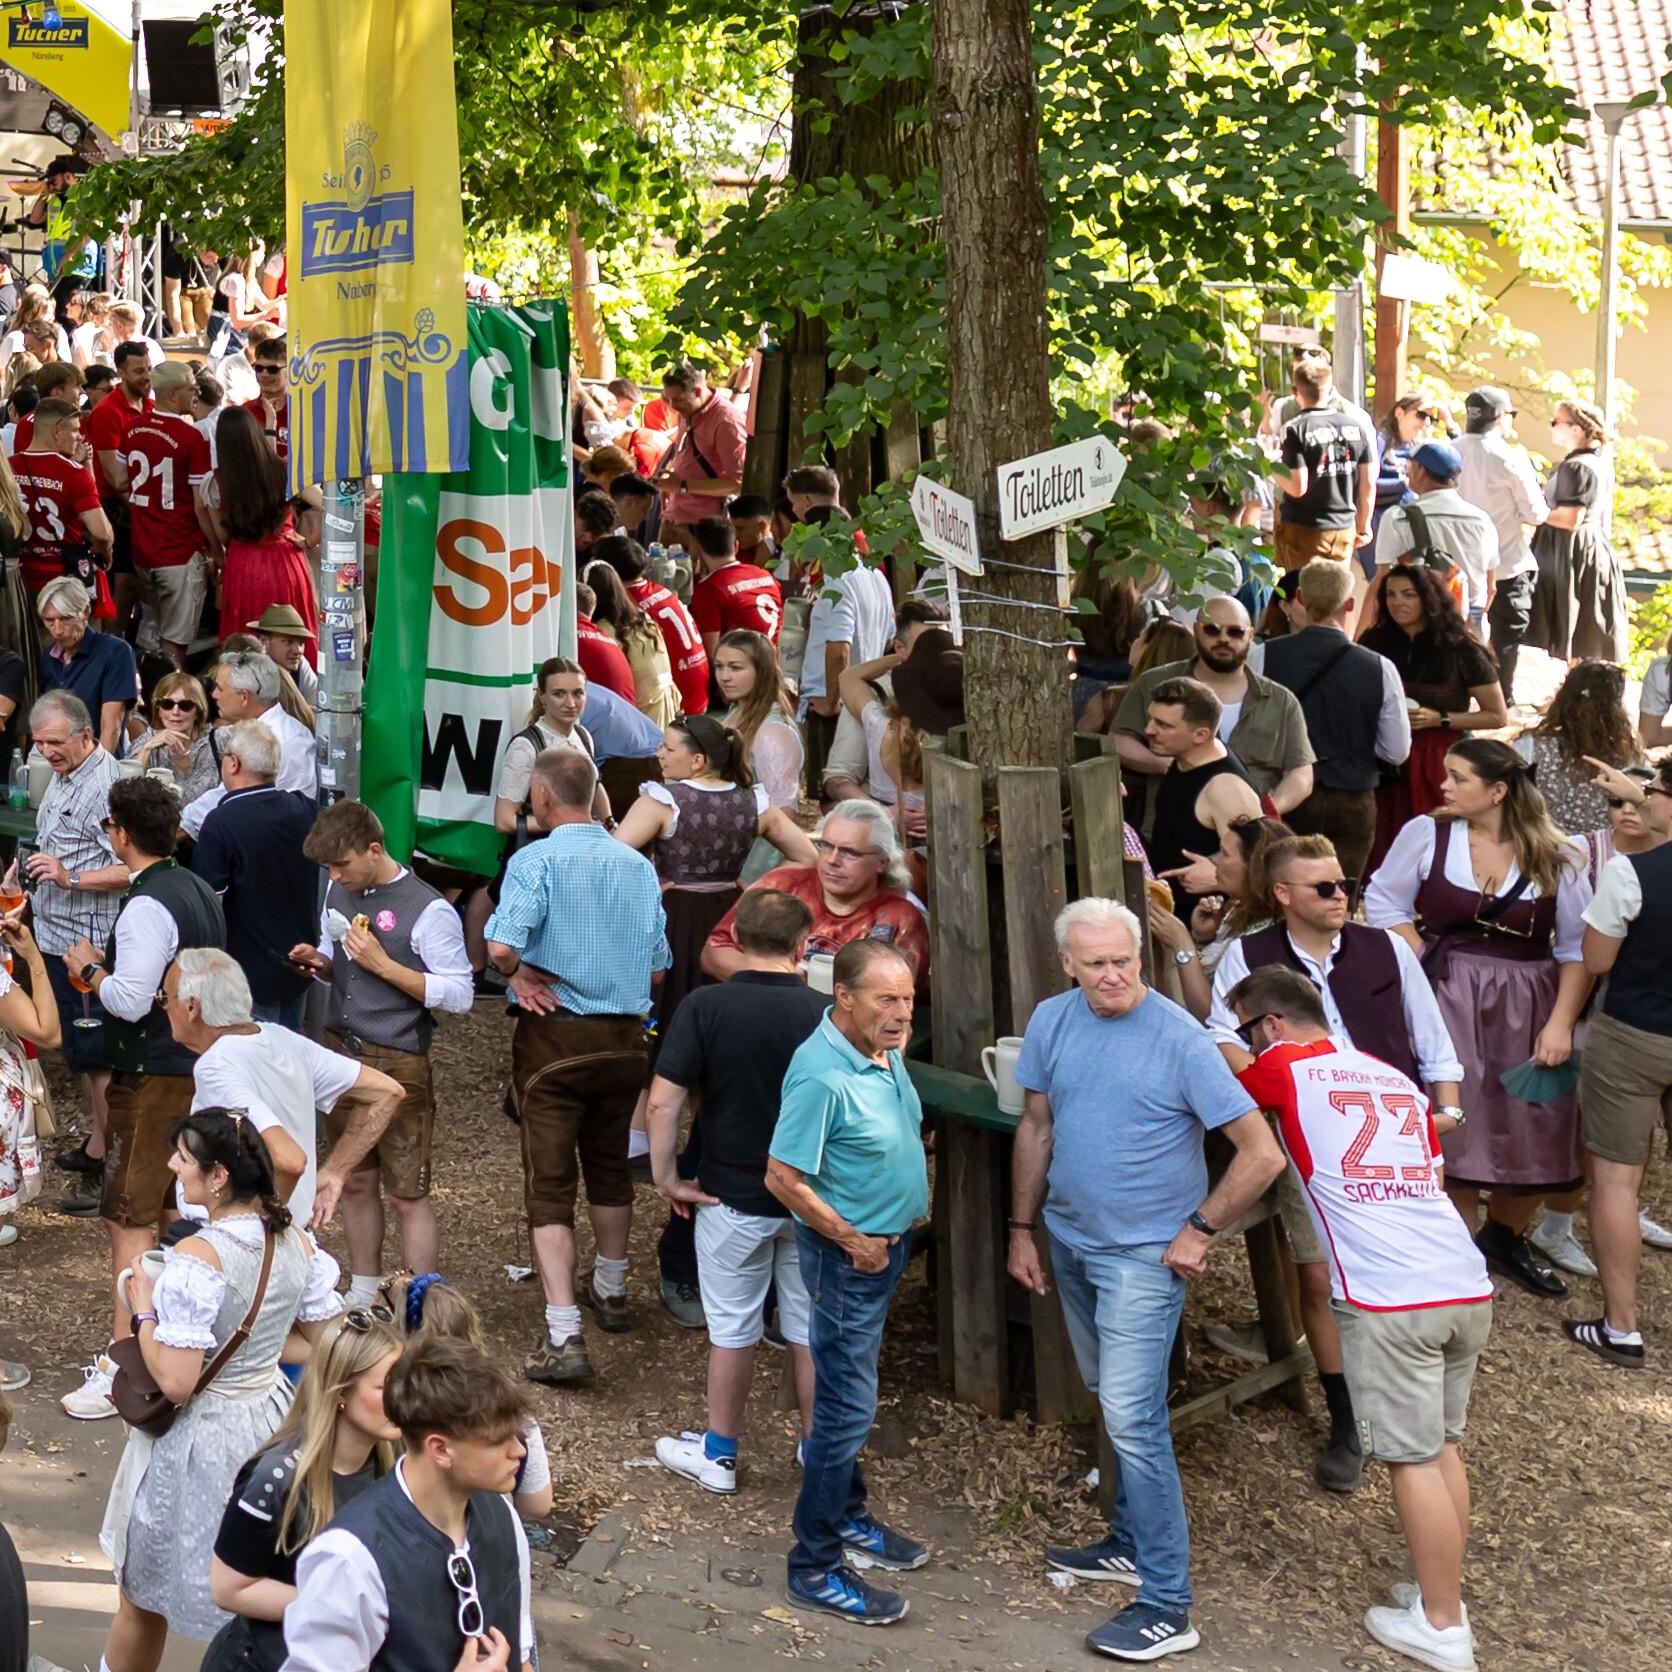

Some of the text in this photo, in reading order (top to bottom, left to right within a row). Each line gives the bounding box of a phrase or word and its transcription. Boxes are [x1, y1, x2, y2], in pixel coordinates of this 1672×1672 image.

[322, 172, 345, 189] Sei
[128, 450, 175, 510] 21
[1006, 464, 1085, 522] Toiletten
[929, 490, 973, 556] Toiletten
[756, 593, 780, 640] 9
[1308, 1068, 1326, 1082] FC
